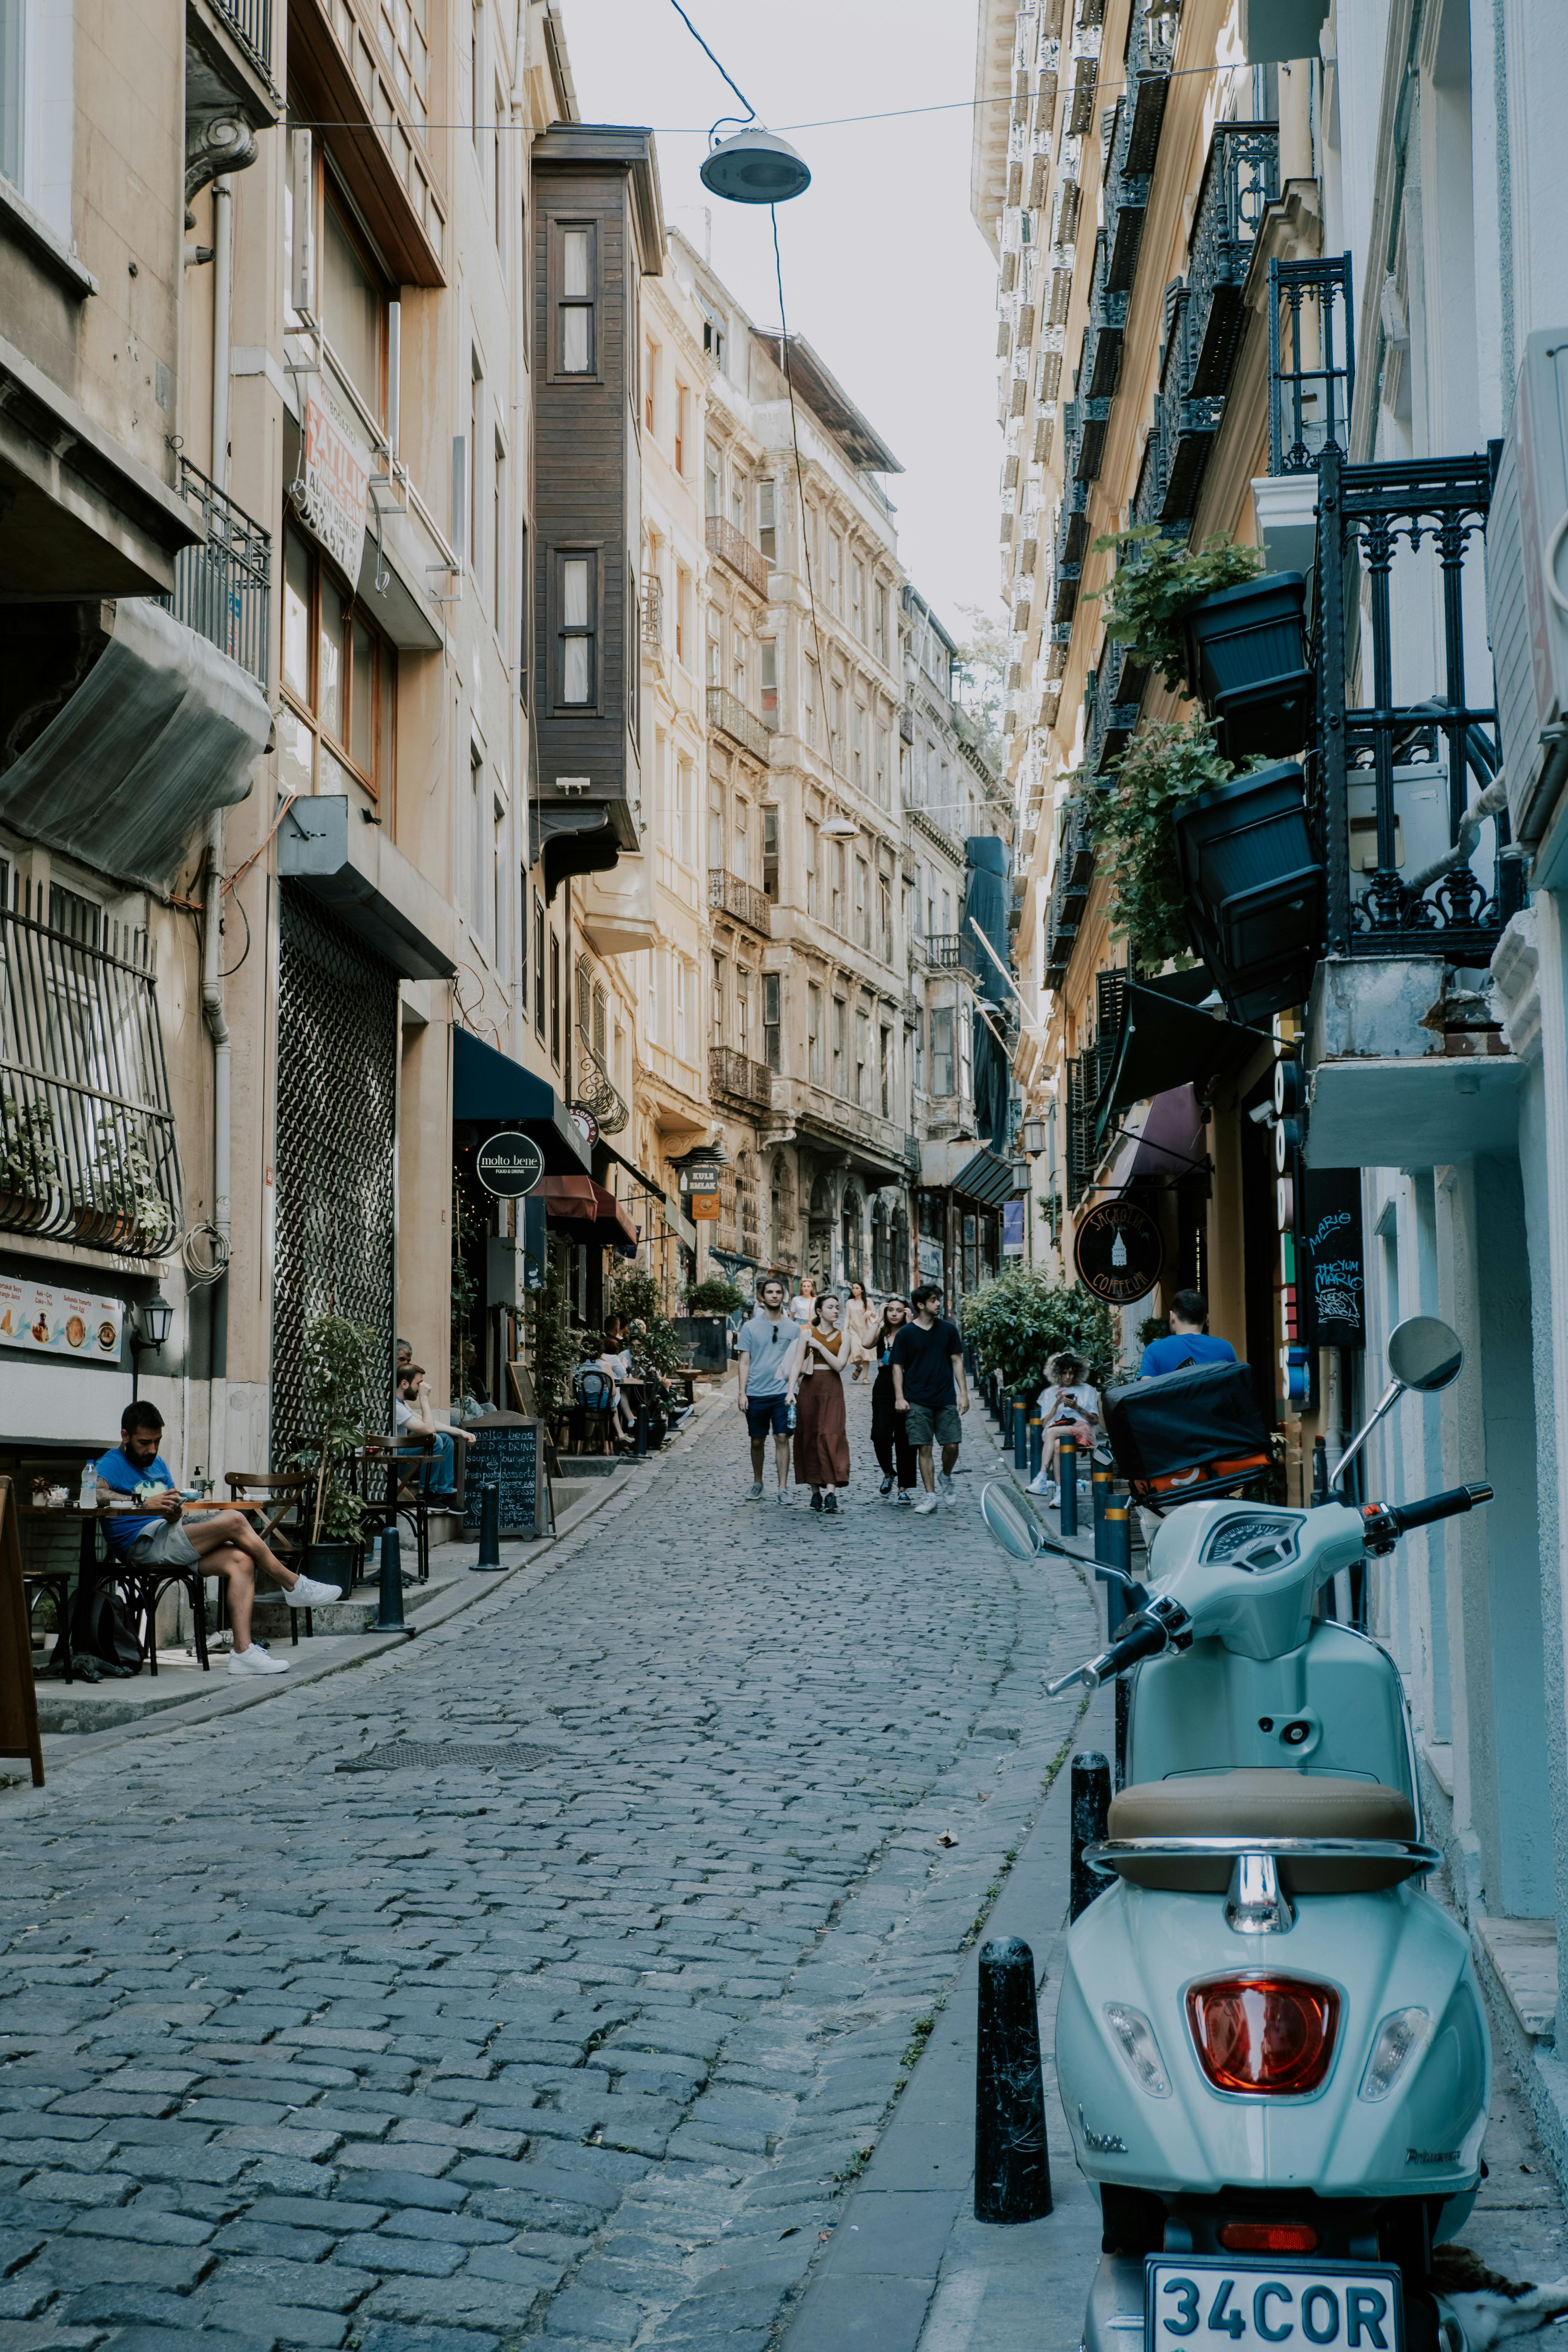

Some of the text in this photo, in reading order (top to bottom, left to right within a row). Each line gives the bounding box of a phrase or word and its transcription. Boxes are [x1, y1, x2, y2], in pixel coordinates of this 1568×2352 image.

[576, 1109, 595, 1128] COFFEE
[482, 1155, 537, 1165] molto bene
[1093, 1271, 1149, 1295] COIFFEUR
[474, 1429, 533, 1439] molto bene
[509, 1442, 536, 1451] DRINK
[466, 1455, 489, 1468] soups
[502, 1452, 535, 1468] burgers
[465, 1468, 500, 1487] fresh pasta
[502, 1466, 535, 1478] desserts
[464, 1490, 482, 1501] pizz
[501, 1489, 535, 1499] espresso
